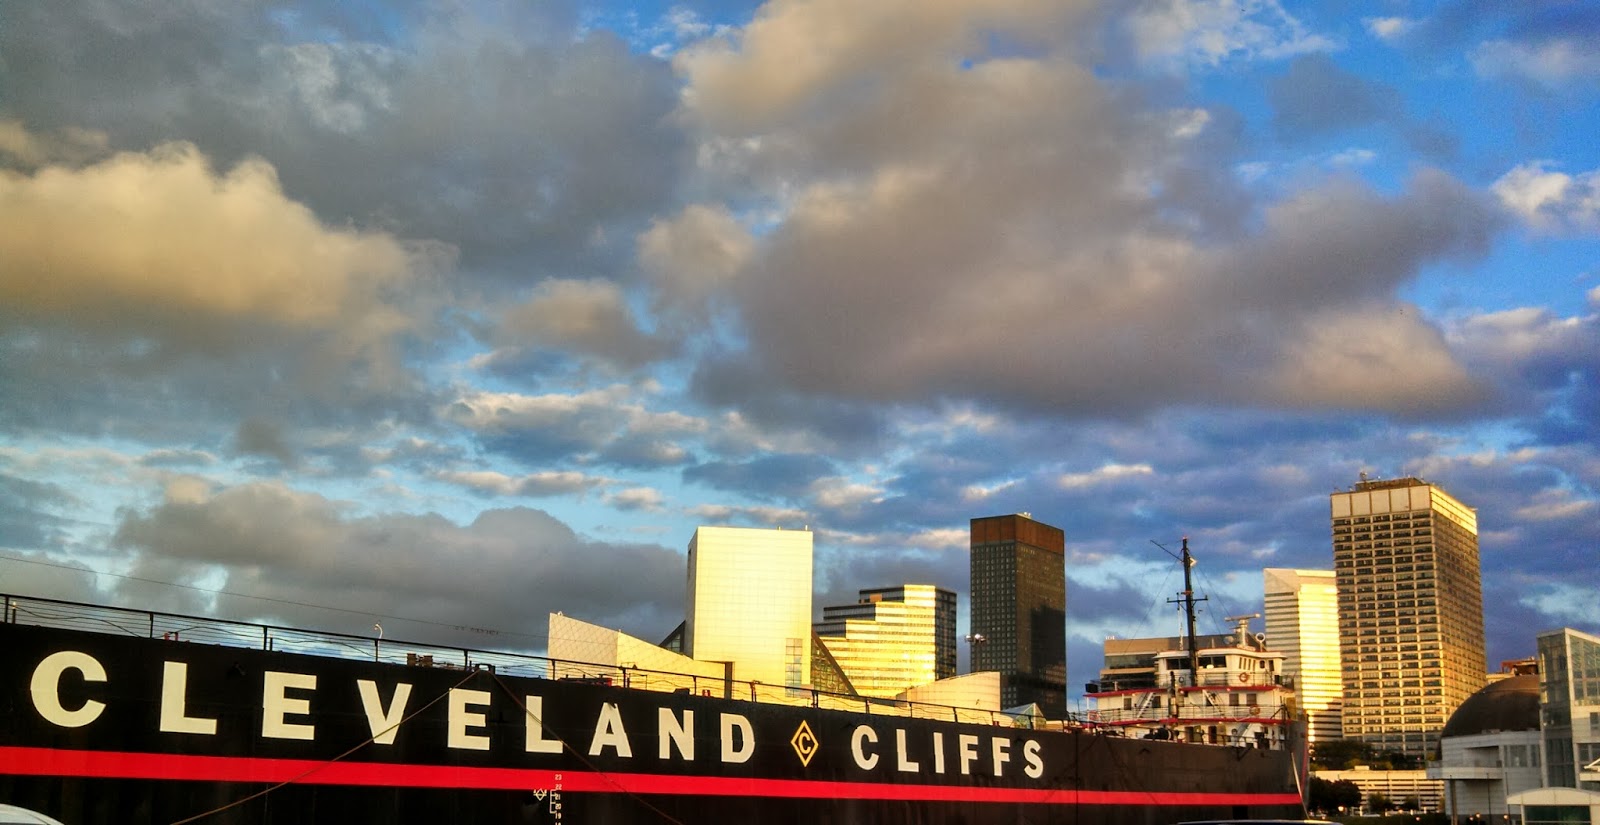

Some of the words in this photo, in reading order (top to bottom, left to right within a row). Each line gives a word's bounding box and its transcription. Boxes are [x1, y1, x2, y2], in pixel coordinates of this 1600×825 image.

[30, 650, 756, 764] CLEVELAND
[798, 732, 812, 755] C
[851, 724, 1045, 779] CLIFFS
